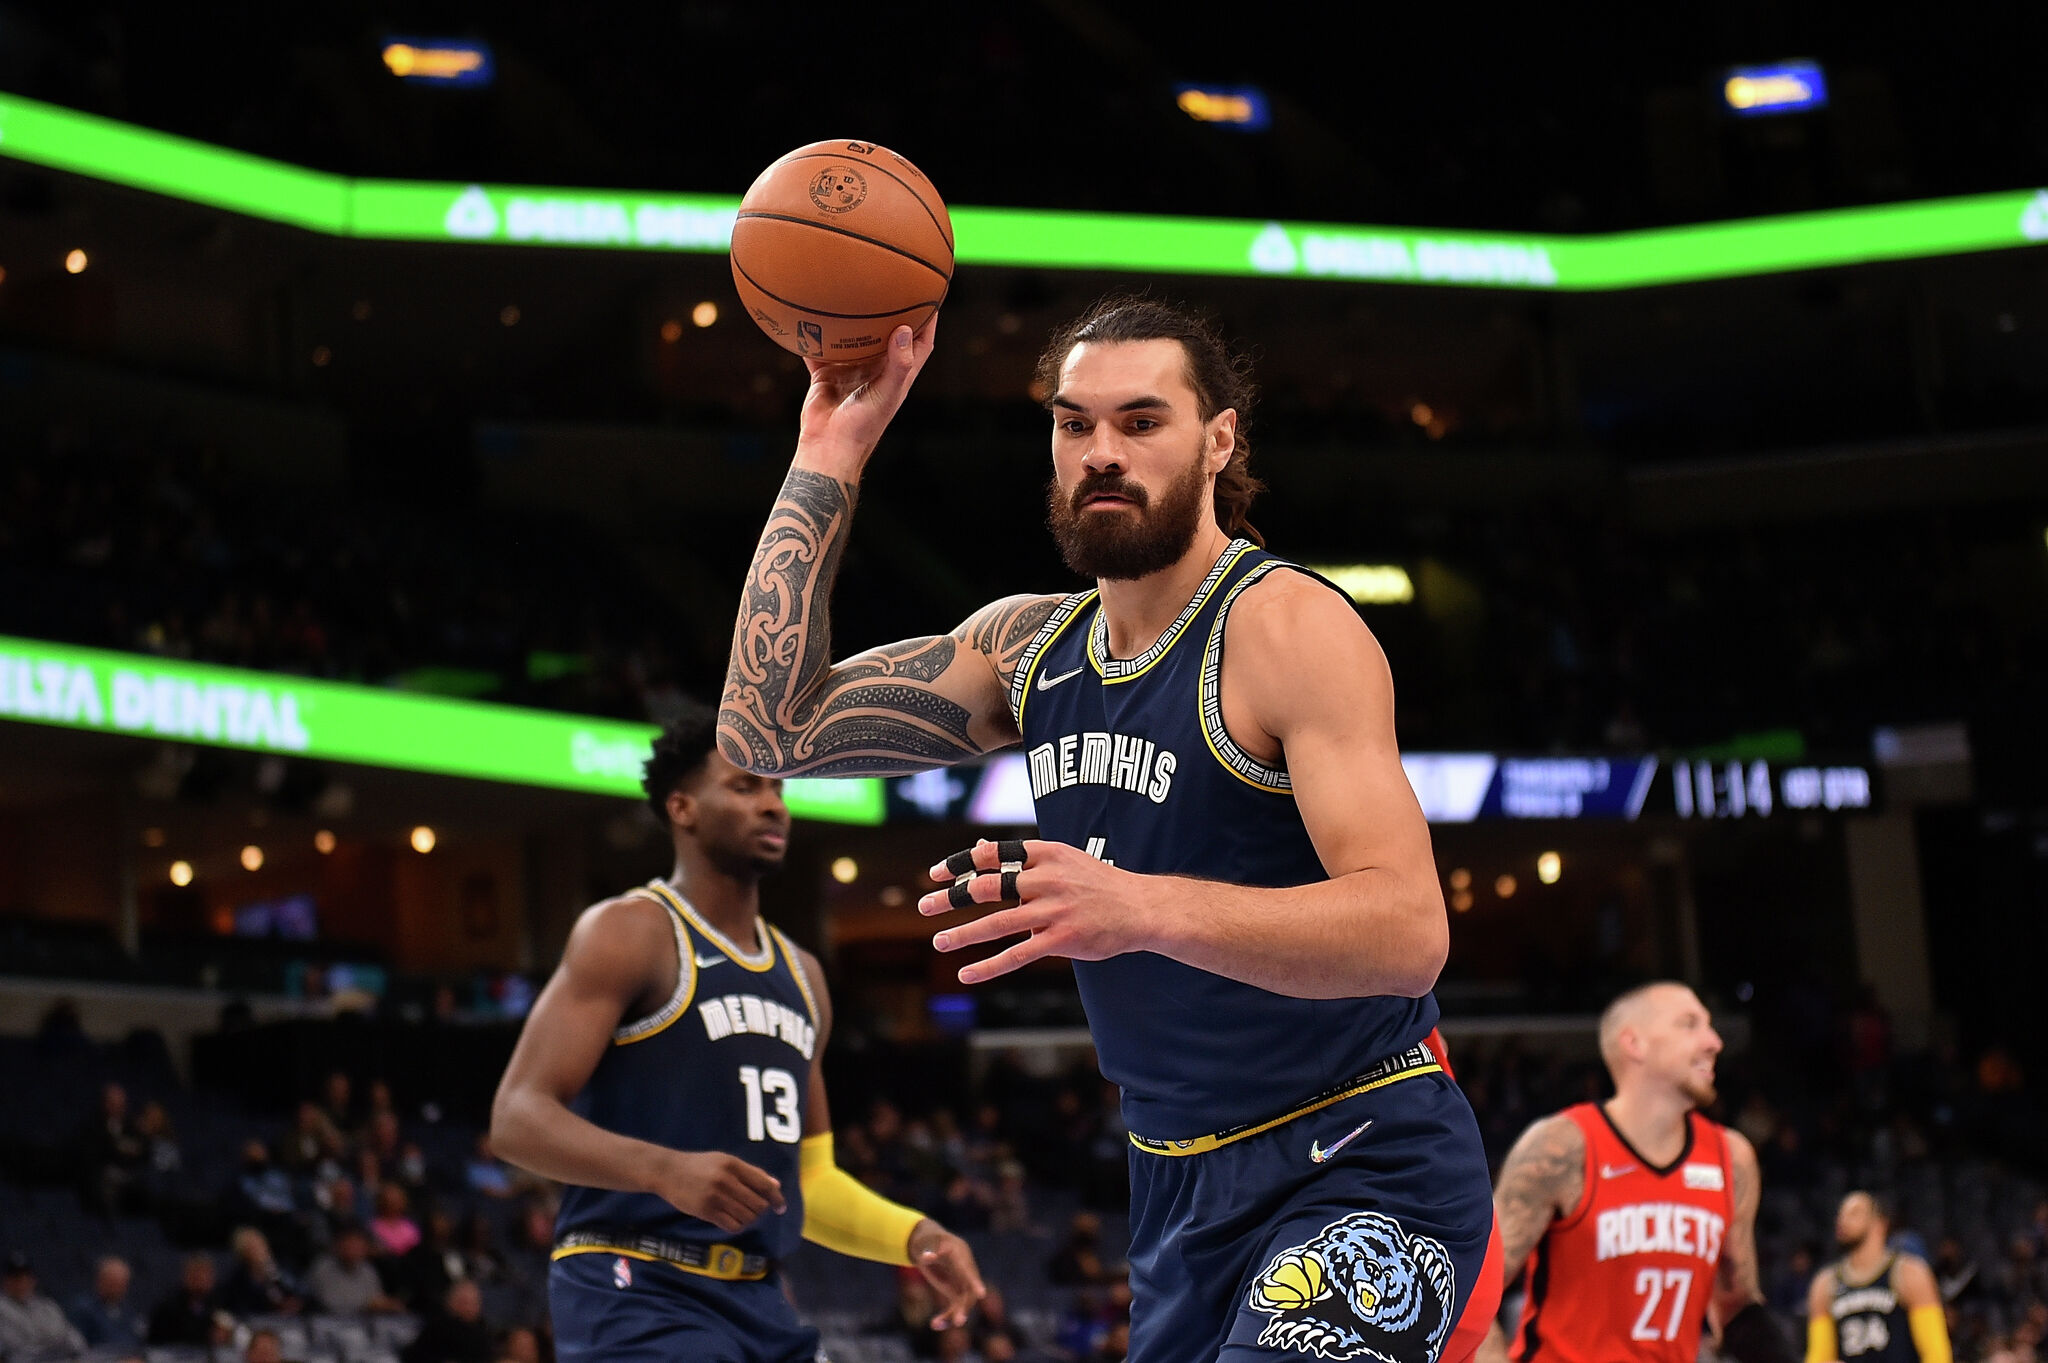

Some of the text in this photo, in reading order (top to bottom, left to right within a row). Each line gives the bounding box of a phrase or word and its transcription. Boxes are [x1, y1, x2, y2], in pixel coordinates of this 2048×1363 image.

[0, 653, 310, 751] ELTA DENTAL
[1028, 732, 1177, 804] MEMPHIS
[698, 994, 816, 1061] MEMPHIS
[739, 1066, 801, 1144] 13
[1597, 1204, 1724, 1265] ROCKETS
[1631, 1268, 1692, 1341] 27
